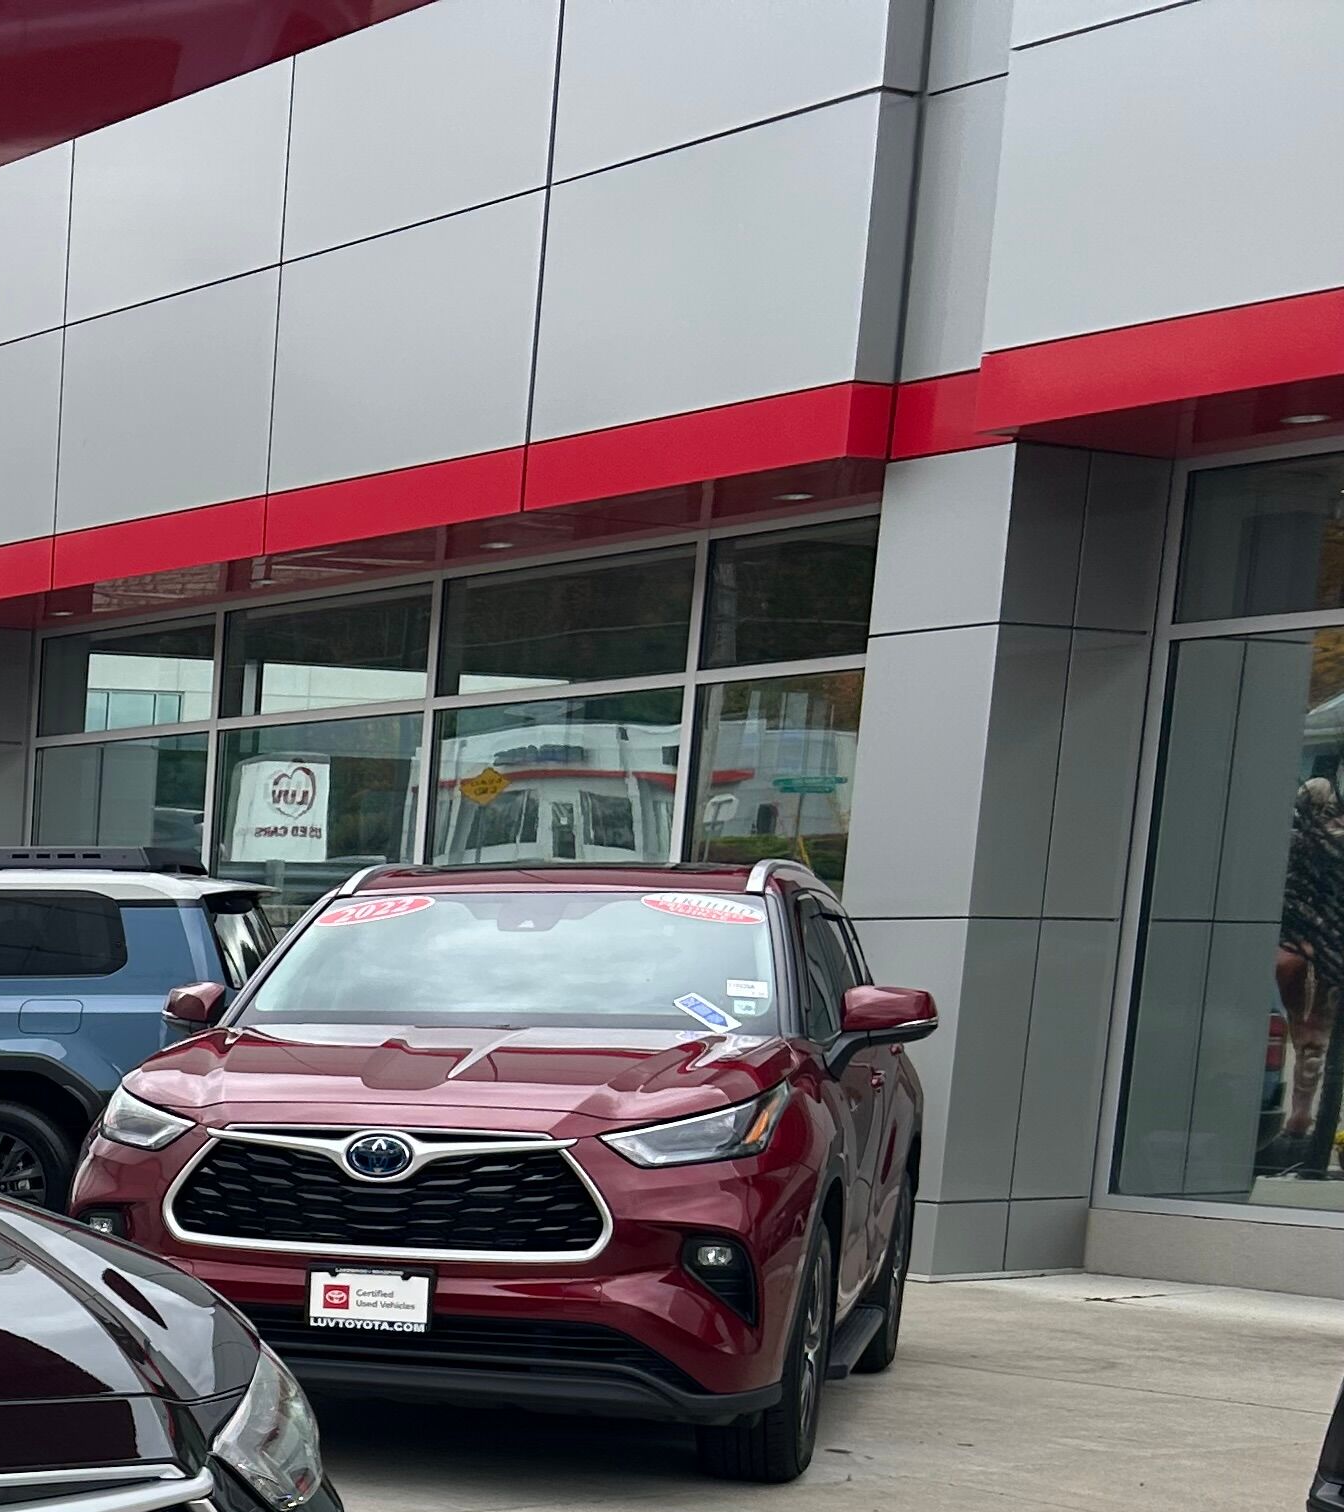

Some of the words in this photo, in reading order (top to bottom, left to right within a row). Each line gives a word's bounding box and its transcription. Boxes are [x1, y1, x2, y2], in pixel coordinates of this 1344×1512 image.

[334, 896, 415, 923] 2022
[356, 1288, 394, 1299] Certified
[356, 1301, 378, 1309] Used
[380, 1301, 416, 1311] Vehicles
[310, 1317, 425, 1333] LUVTOYOTA.COM
